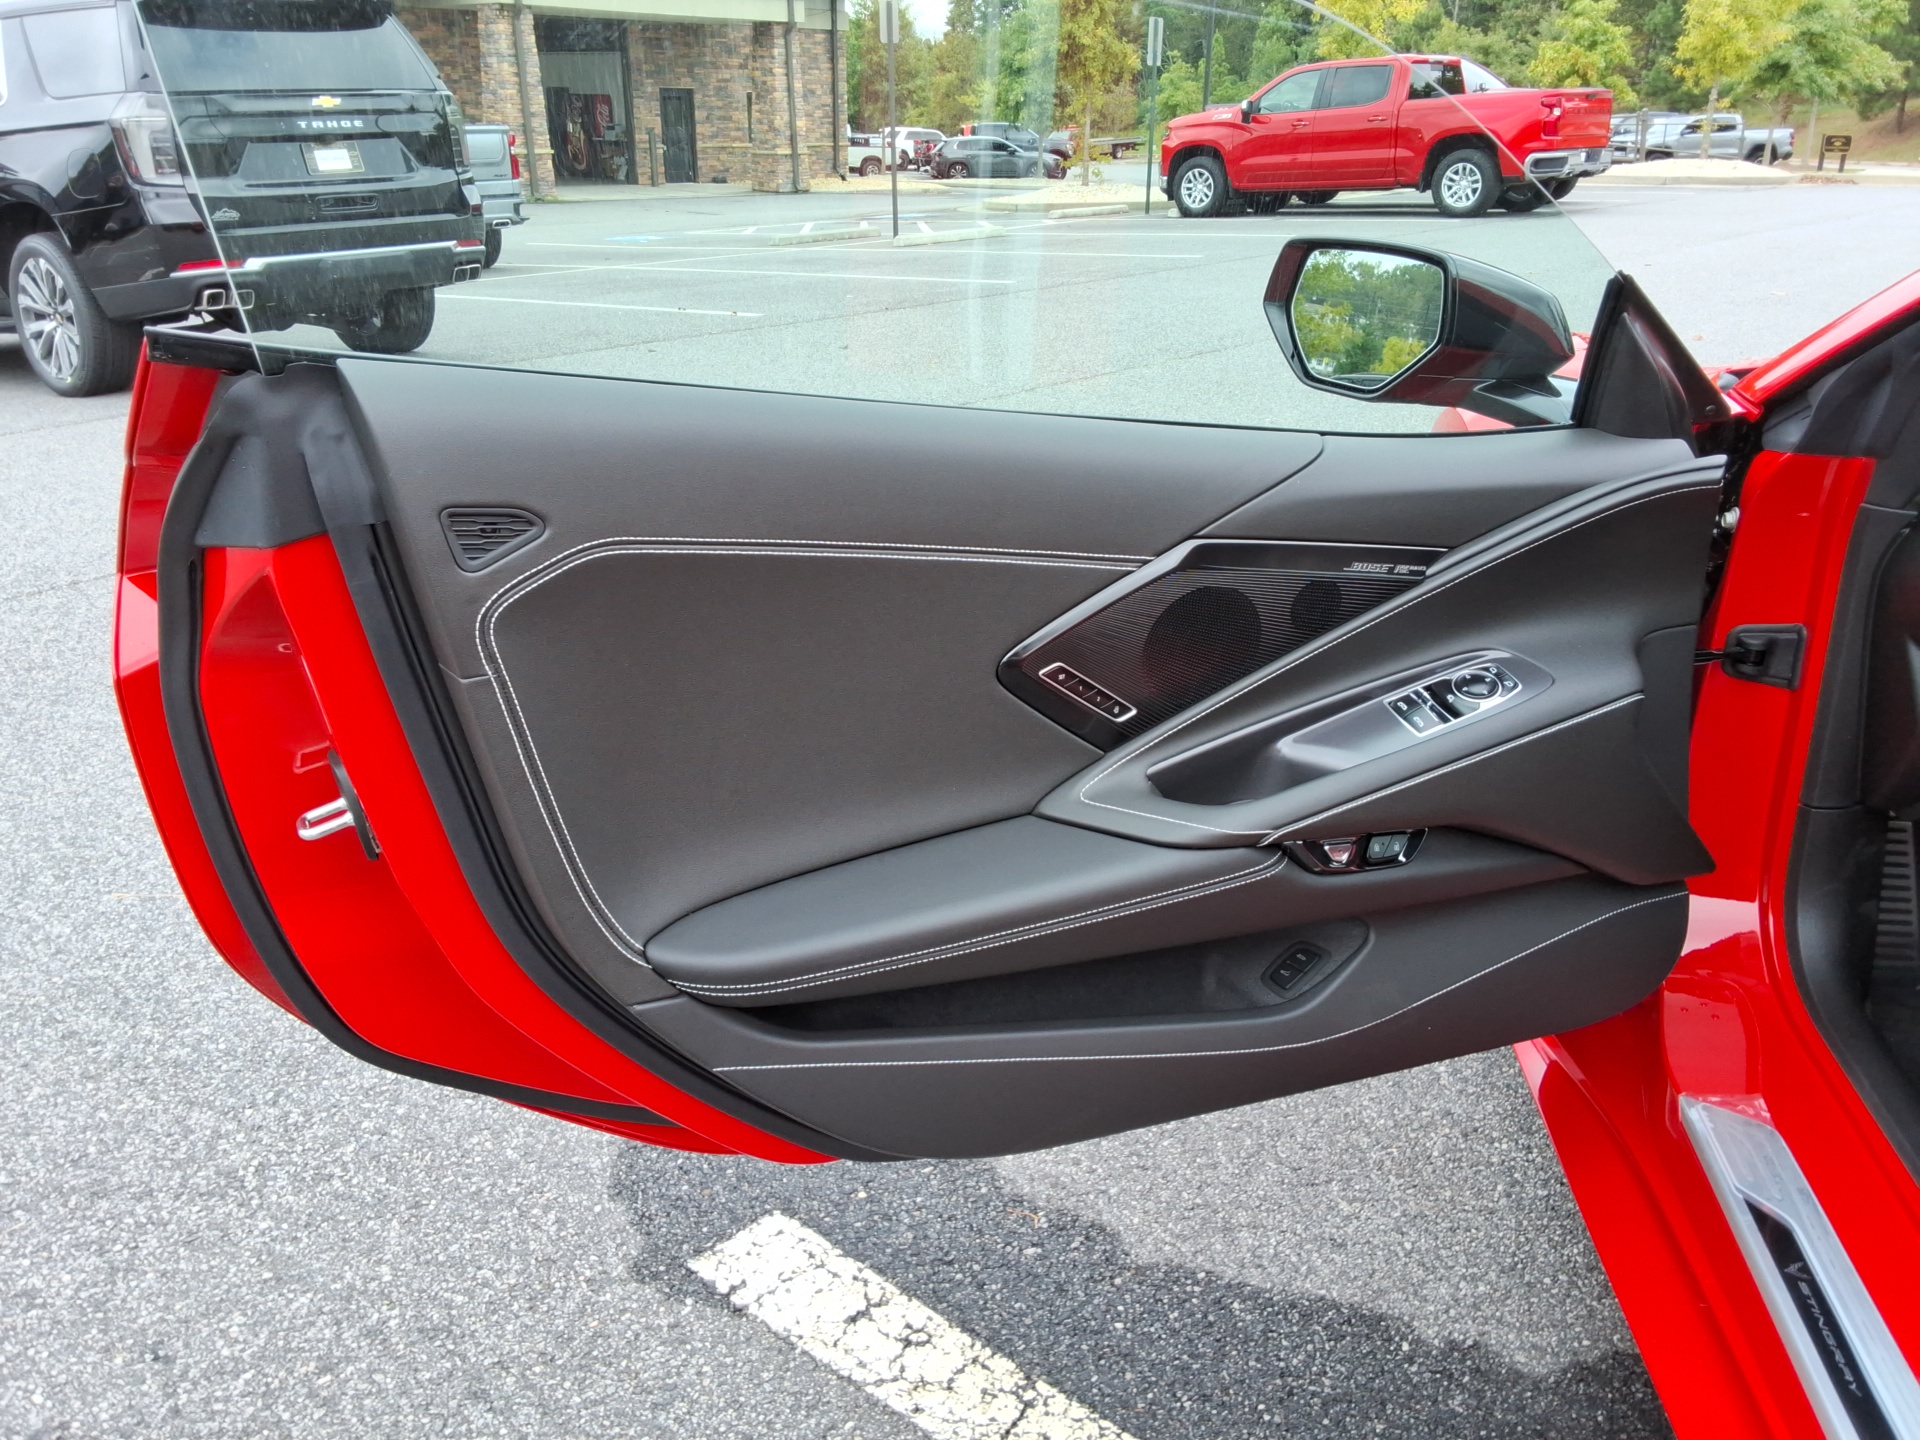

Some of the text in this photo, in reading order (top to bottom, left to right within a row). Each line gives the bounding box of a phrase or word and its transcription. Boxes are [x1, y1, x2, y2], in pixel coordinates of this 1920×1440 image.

[297, 120, 364, 129] TAHOE
[1343, 562, 1394, 573] BOSE
[1797, 1281, 1862, 1397] STINGRAY
